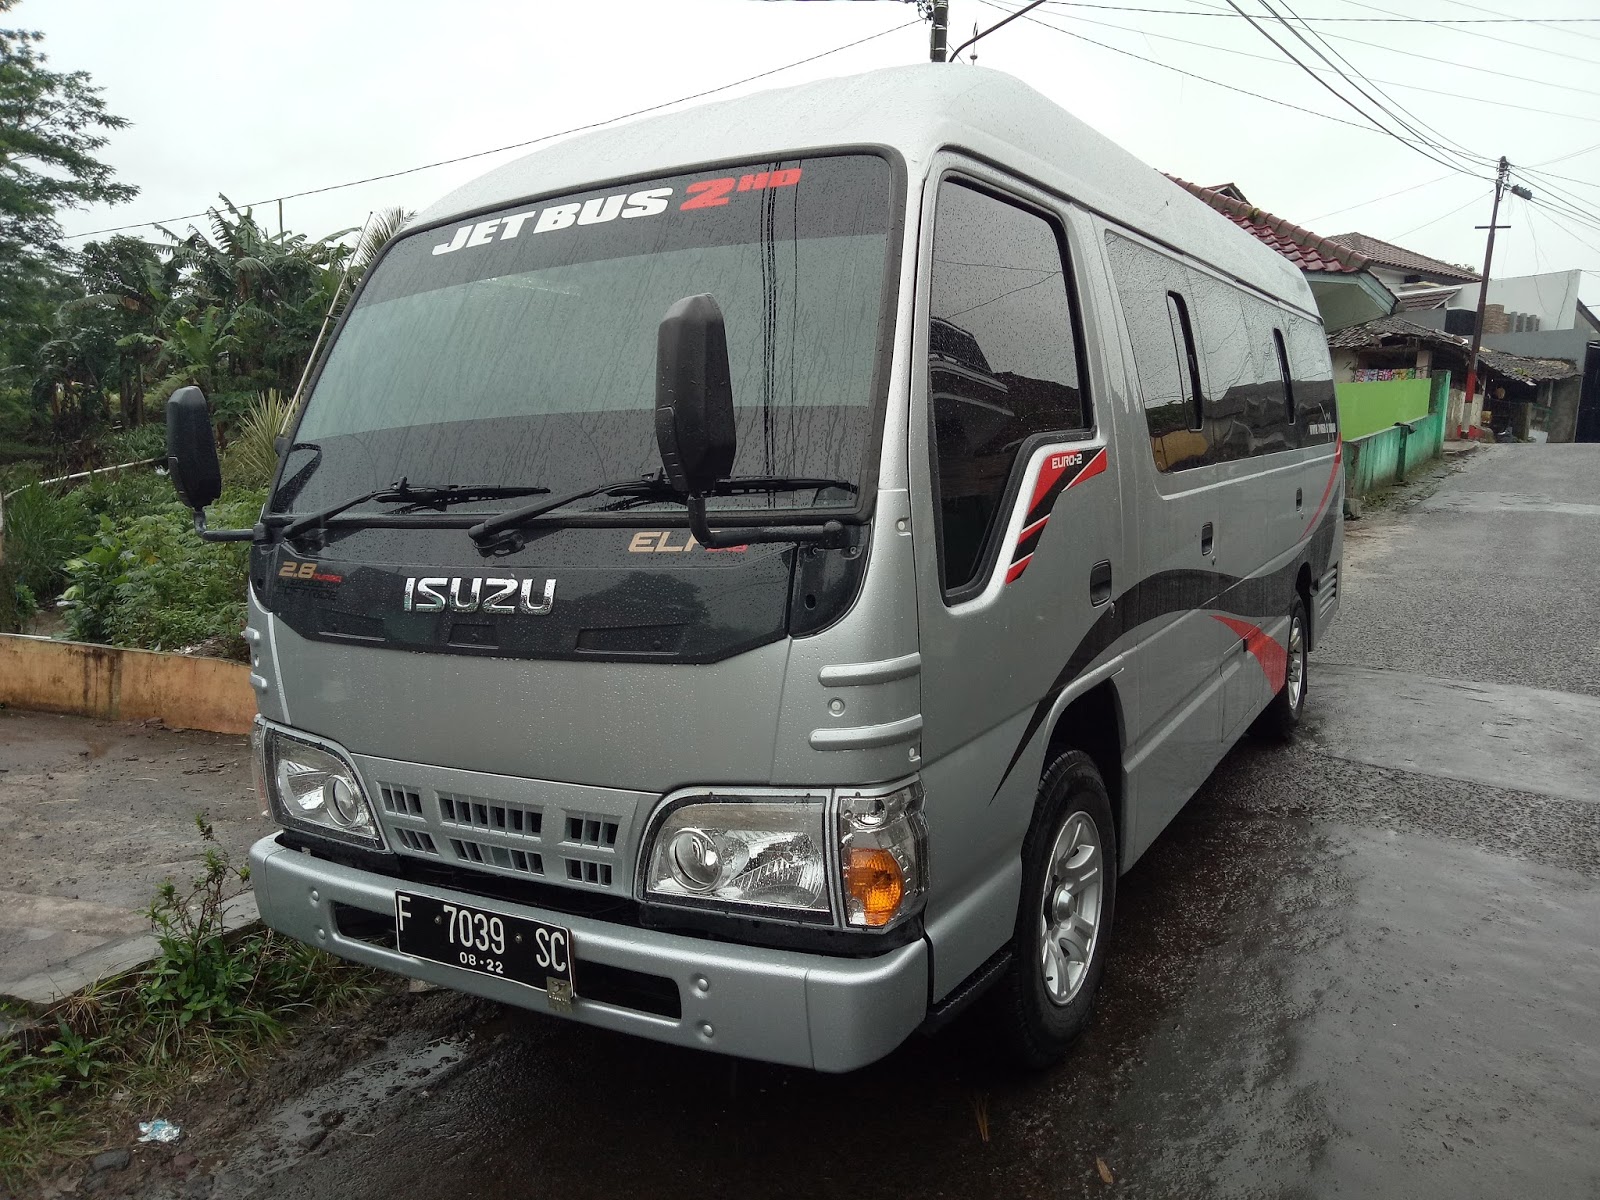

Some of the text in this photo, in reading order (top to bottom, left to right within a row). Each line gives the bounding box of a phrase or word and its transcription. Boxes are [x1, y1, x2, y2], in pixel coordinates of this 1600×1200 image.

[1052, 454, 1082, 469] EURO-2
[279, 561, 318, 579] 2.8
[404, 577, 557, 616] ISUZU
[398, 895, 566, 972] F 7039 SC
